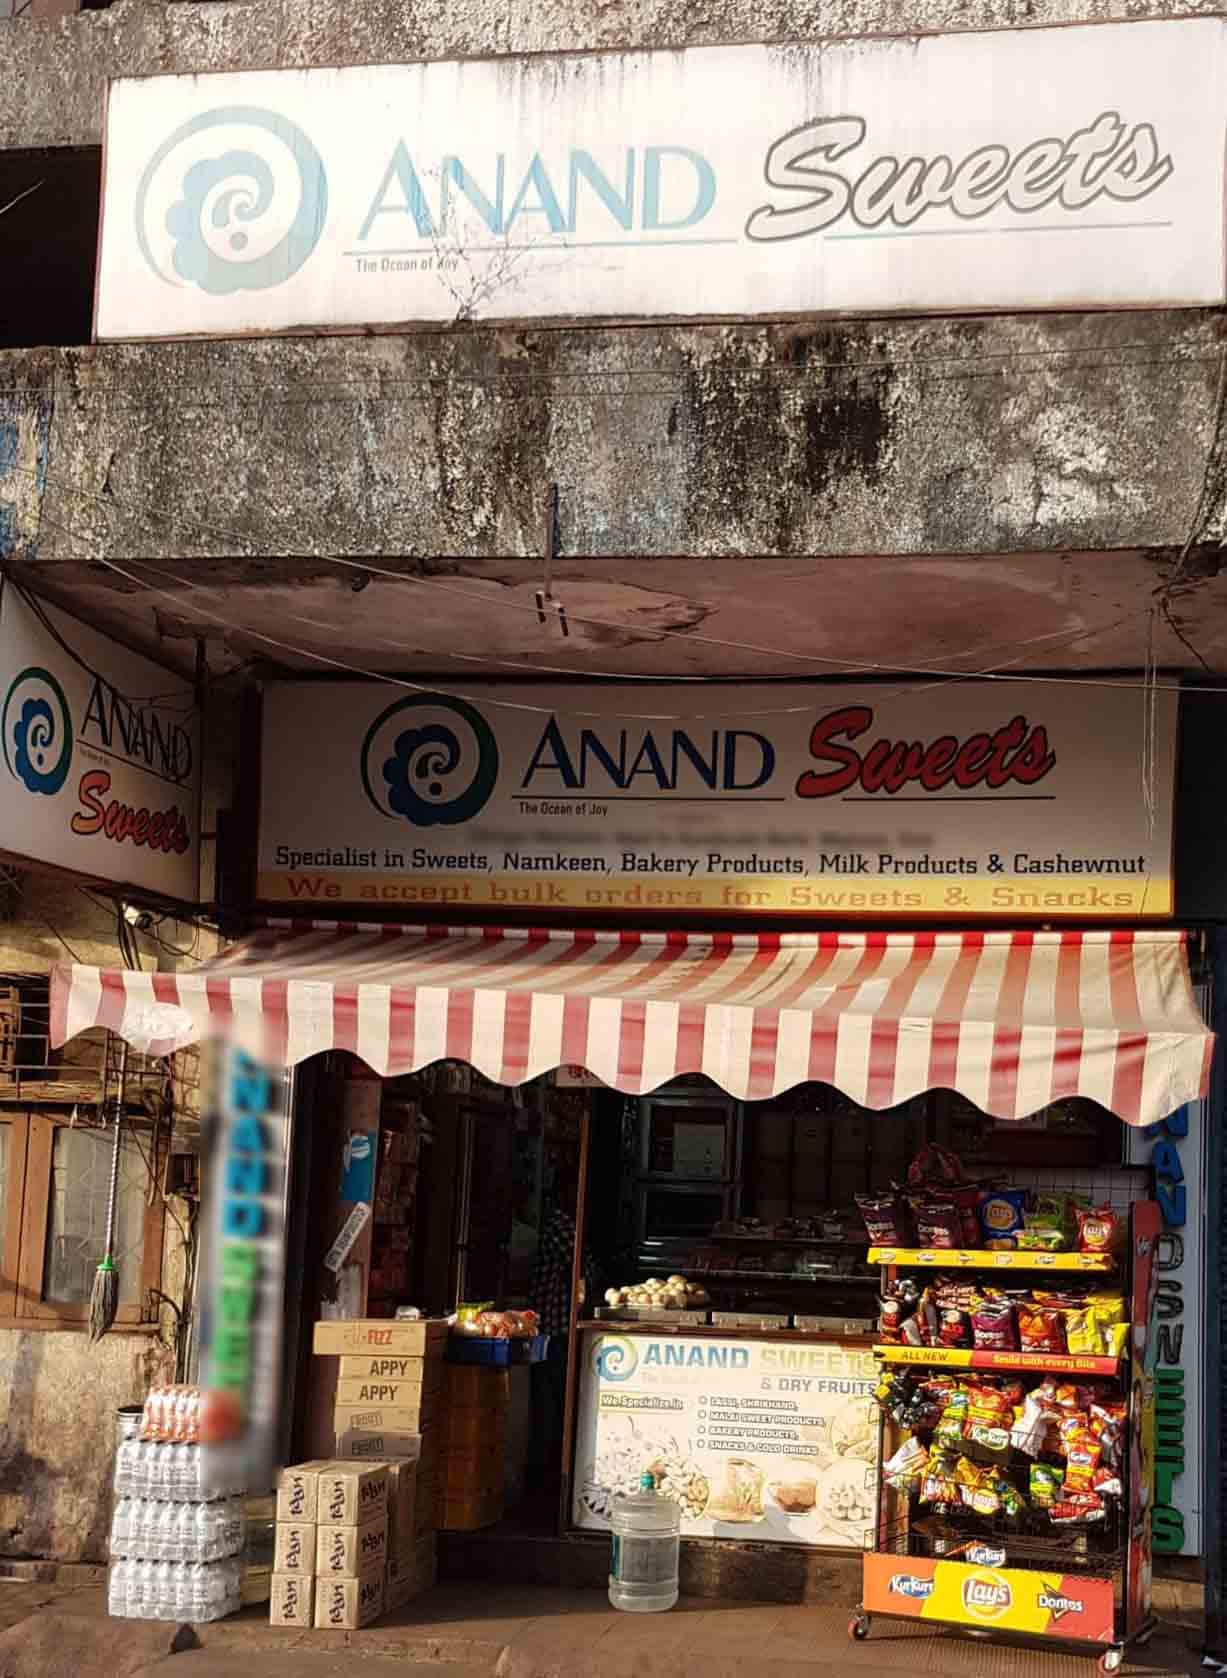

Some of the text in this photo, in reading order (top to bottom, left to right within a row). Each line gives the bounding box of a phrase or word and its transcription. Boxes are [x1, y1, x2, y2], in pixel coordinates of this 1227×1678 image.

[356, 111, 1174, 242] ANAND Sweets
[356, 258, 377, 272] The
[381, 257, 417, 272] Ocean
[420, 257, 433, 271] of
[80, 677, 193, 779] ANAND
[520, 706, 1056, 799] ANAND Sweets
[71, 769, 190, 854] Sweets
[520, 801, 608, 816] The Ocean of Joy
[275, 846, 1145, 876] Specialist in Sweets, Namkeen, Bakery Products, Milk Products & Cashewnut
[287, 877, 1133, 907] We accept bulk orders for Sweets & Snacks
[370, 1359, 408, 1376] APPY
[644, 1343, 881, 1376] ANAND SWEETS
[922, 1351, 950, 1362] NEW
[359, 1384, 399, 1401] APPY
[779, 1378, 811, 1394] DRY
[818, 1380, 878, 1397] FRUITS
[1038, 1594, 1083, 1613] Doritos
